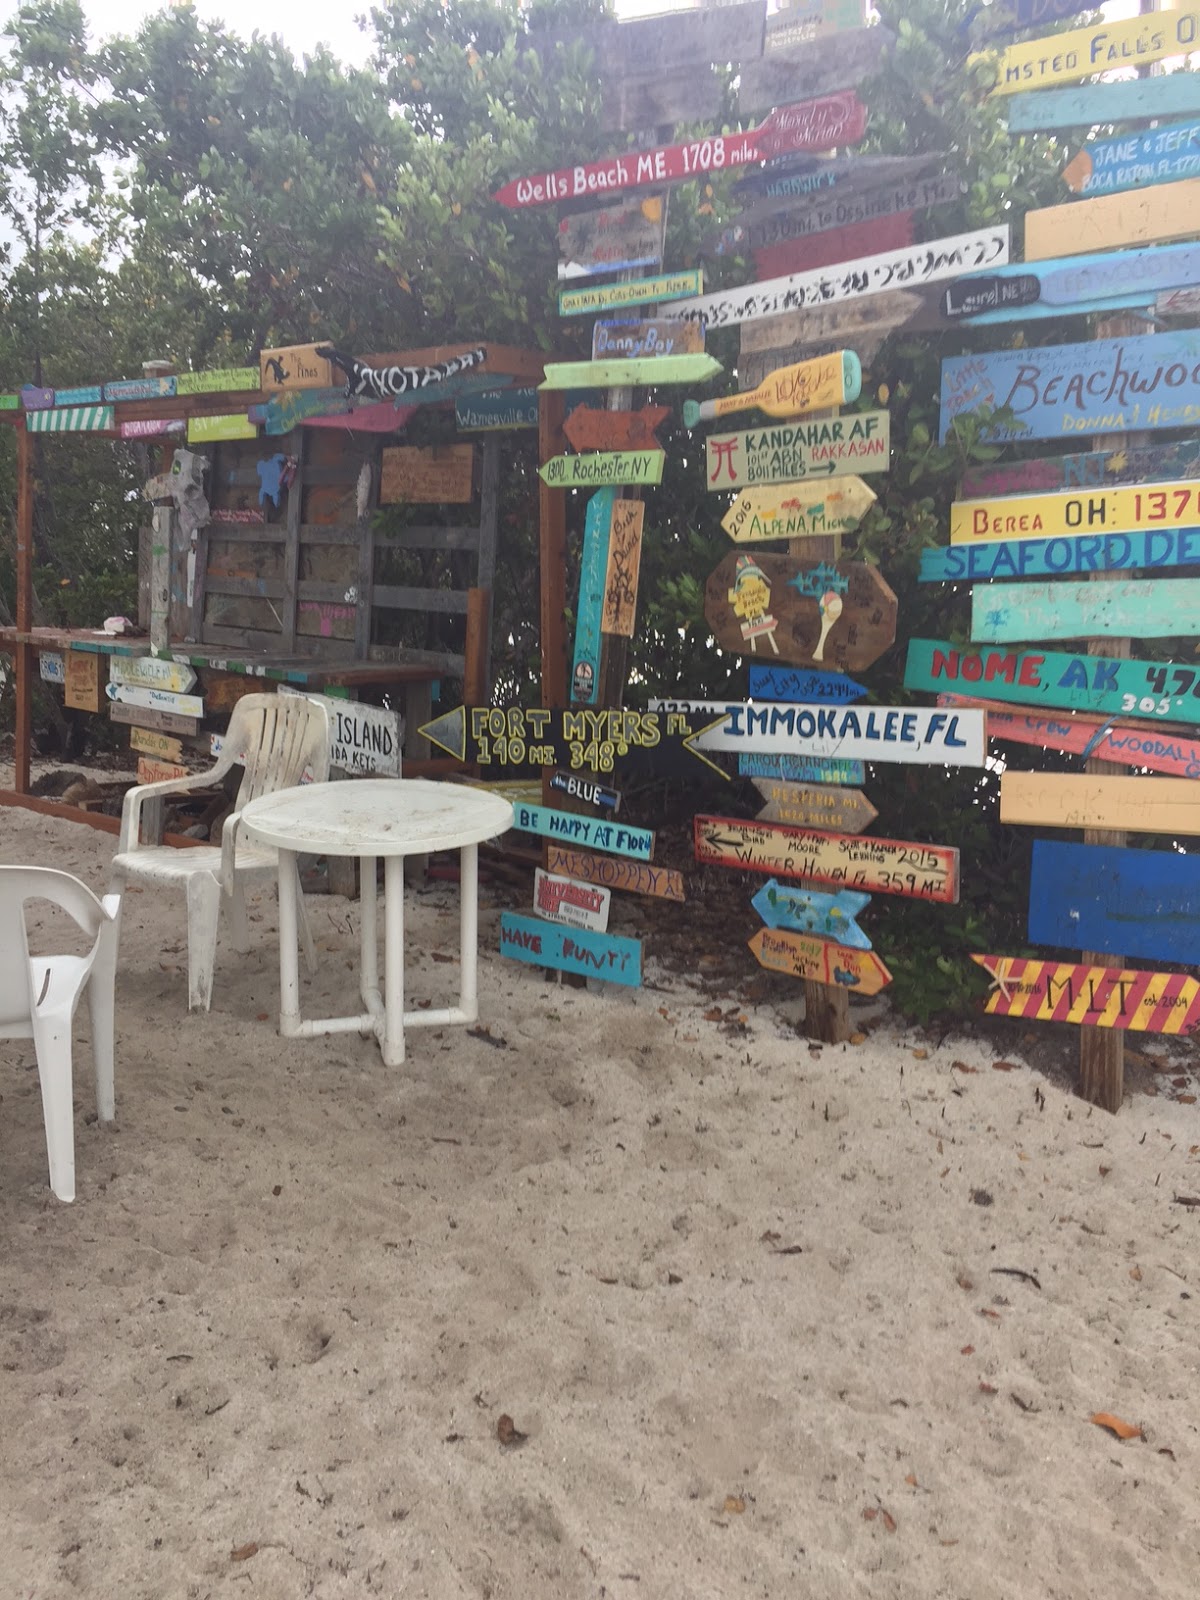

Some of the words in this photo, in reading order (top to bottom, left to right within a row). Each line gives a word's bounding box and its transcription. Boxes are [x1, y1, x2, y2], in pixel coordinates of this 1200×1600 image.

[1004, 50, 1078, 84] MSTED
[1093, 139, 1139, 168] JANE
[517, 175, 567, 203] Wells
[573, 160, 628, 195] Beach
[682, 138, 725, 173] 1708
[745, 420, 843, 453] KANDAHAR
[849, 416, 879, 441] AF
[811, 438, 885, 461] RAKKASAN
[631, 456, 652, 478] NY
[772, 460, 807, 479] MILES
[973, 508, 1044, 535] BEREA
[1134, 489, 1200, 522] 137
[1057, 659, 1121, 692] AK
[336, 712, 394, 757] ISLAND
[472, 706, 552, 740] FORT
[563, 710, 660, 747] MYERS
[667, 713, 692, 736] FL
[924, 713, 967, 748] FL
[352, 753, 377, 771] KEYS
[567, 778, 603, 805] BLUE
[519, 809, 539, 828] BE
[549, 815, 591, 841] HAPPY
[593, 825, 614, 847] AT
[500, 925, 543, 955] HAVE
